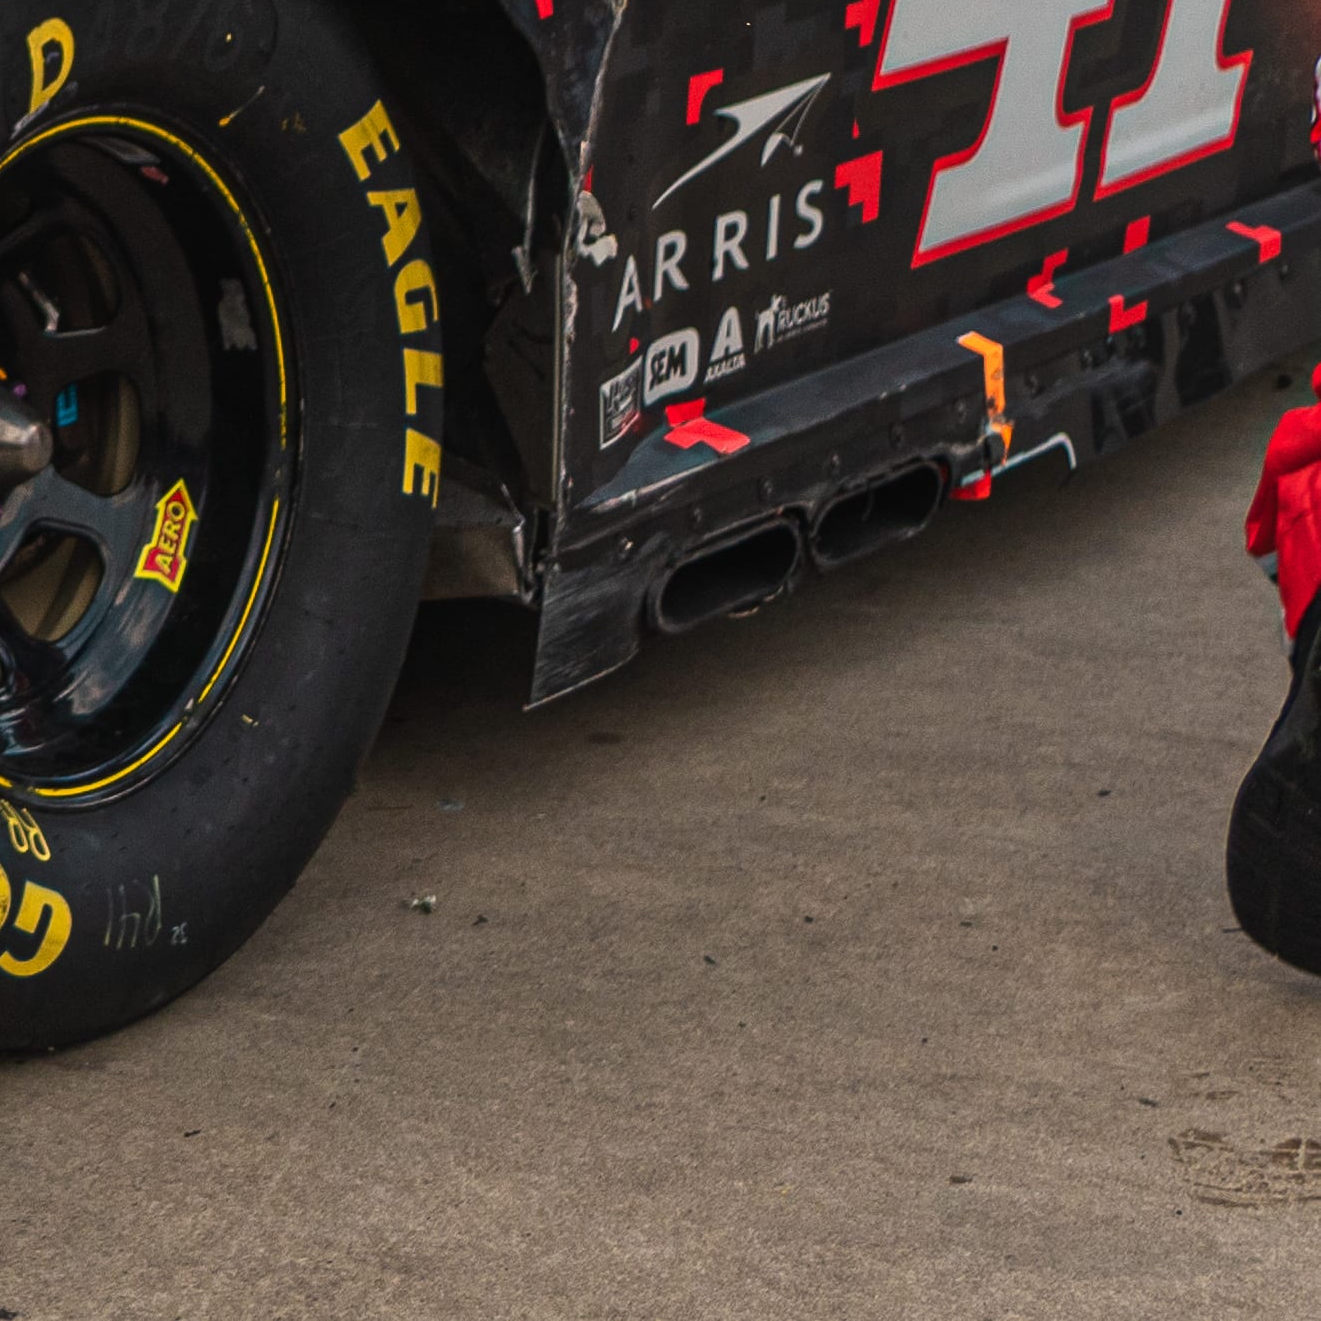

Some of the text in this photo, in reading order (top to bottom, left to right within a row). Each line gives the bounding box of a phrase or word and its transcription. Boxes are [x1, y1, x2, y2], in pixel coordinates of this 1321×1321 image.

[338, 98, 444, 510] EAGLE
[611, 179, 824, 334] ARRIS
[155, 500, 186, 577] AERO
